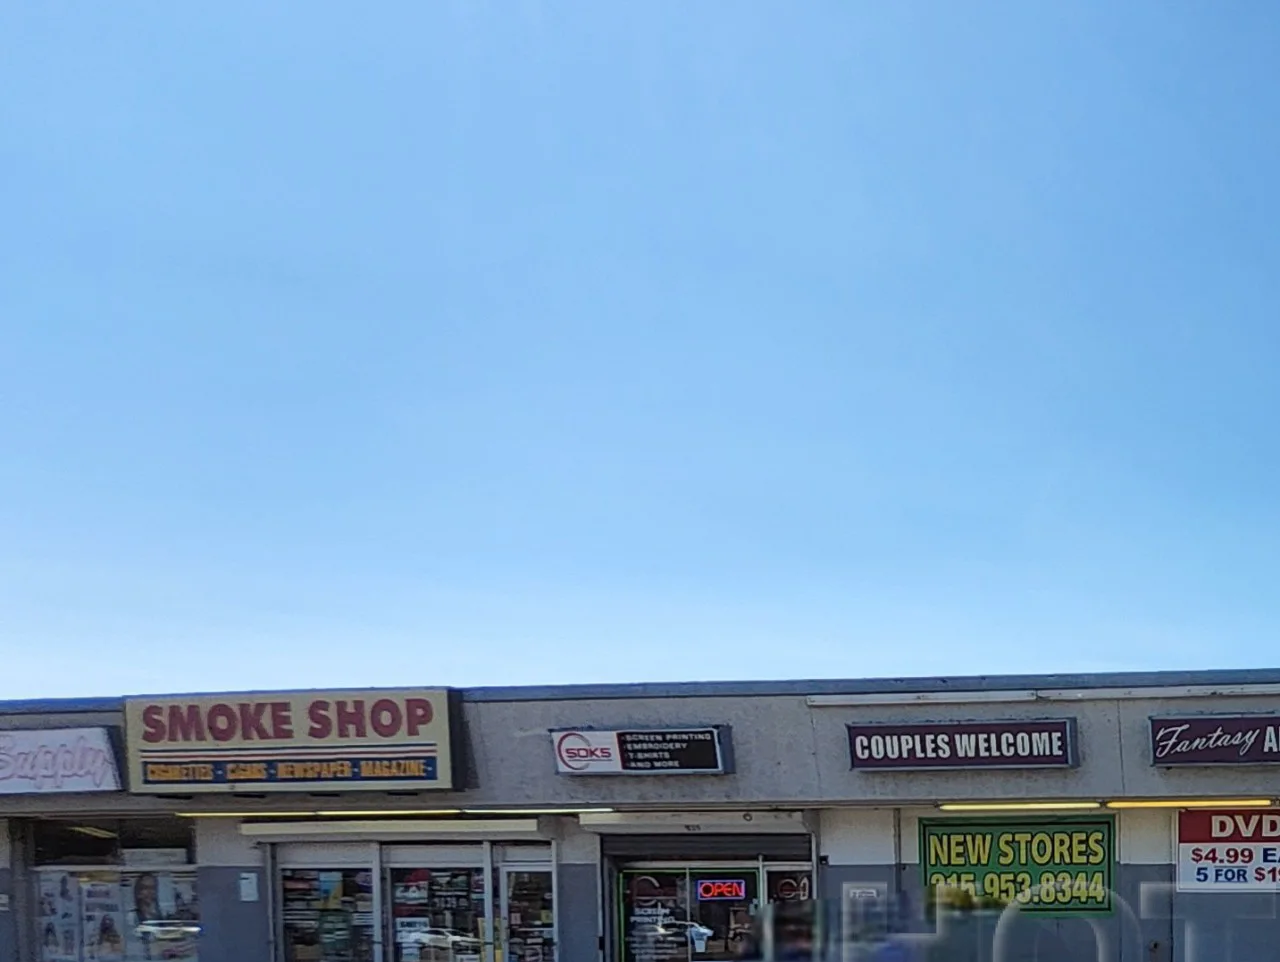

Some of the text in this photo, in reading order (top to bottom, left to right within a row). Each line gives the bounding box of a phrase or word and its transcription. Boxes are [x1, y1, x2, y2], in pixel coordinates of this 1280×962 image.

[142, 699, 434, 743] SMOKE SHOP
[855, 732, 1063, 760] COUPLES WELCOME
[1156, 724, 1260, 758] Fantasy
[929, 832, 1106, 865] NEW STORES
[1191, 847, 1254, 864] $4.99
[1196, 867, 1209, 882] 5
[1214, 868, 1248, 882] FOR
[700, 882, 743, 897] OPEN
